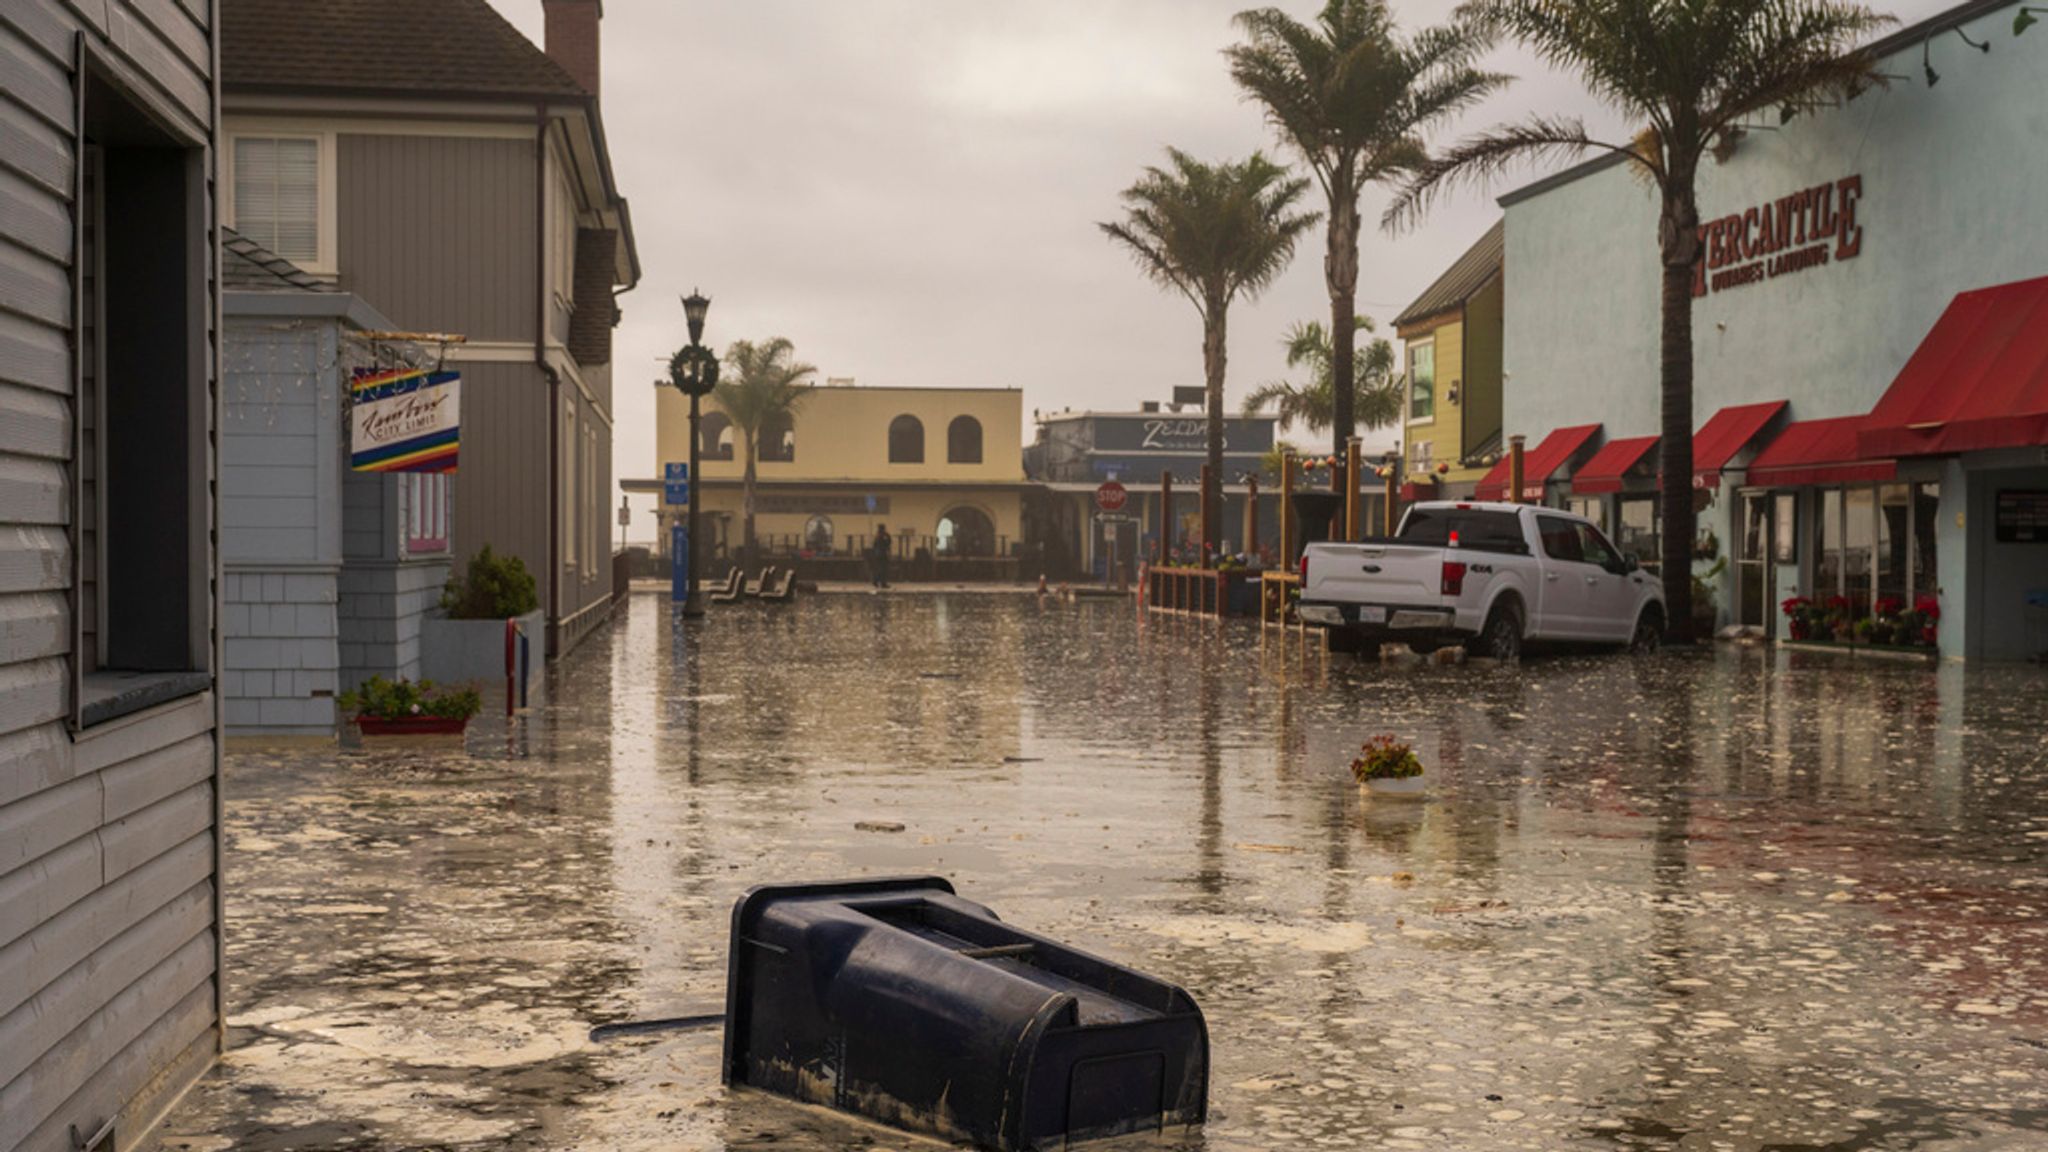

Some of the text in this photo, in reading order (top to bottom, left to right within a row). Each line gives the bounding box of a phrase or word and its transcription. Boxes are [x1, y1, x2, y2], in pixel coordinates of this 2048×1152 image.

[1767, 243, 1829, 278] LANDING
[376, 424, 400, 438] CITY
[1098, 490, 1126, 502] STOP
